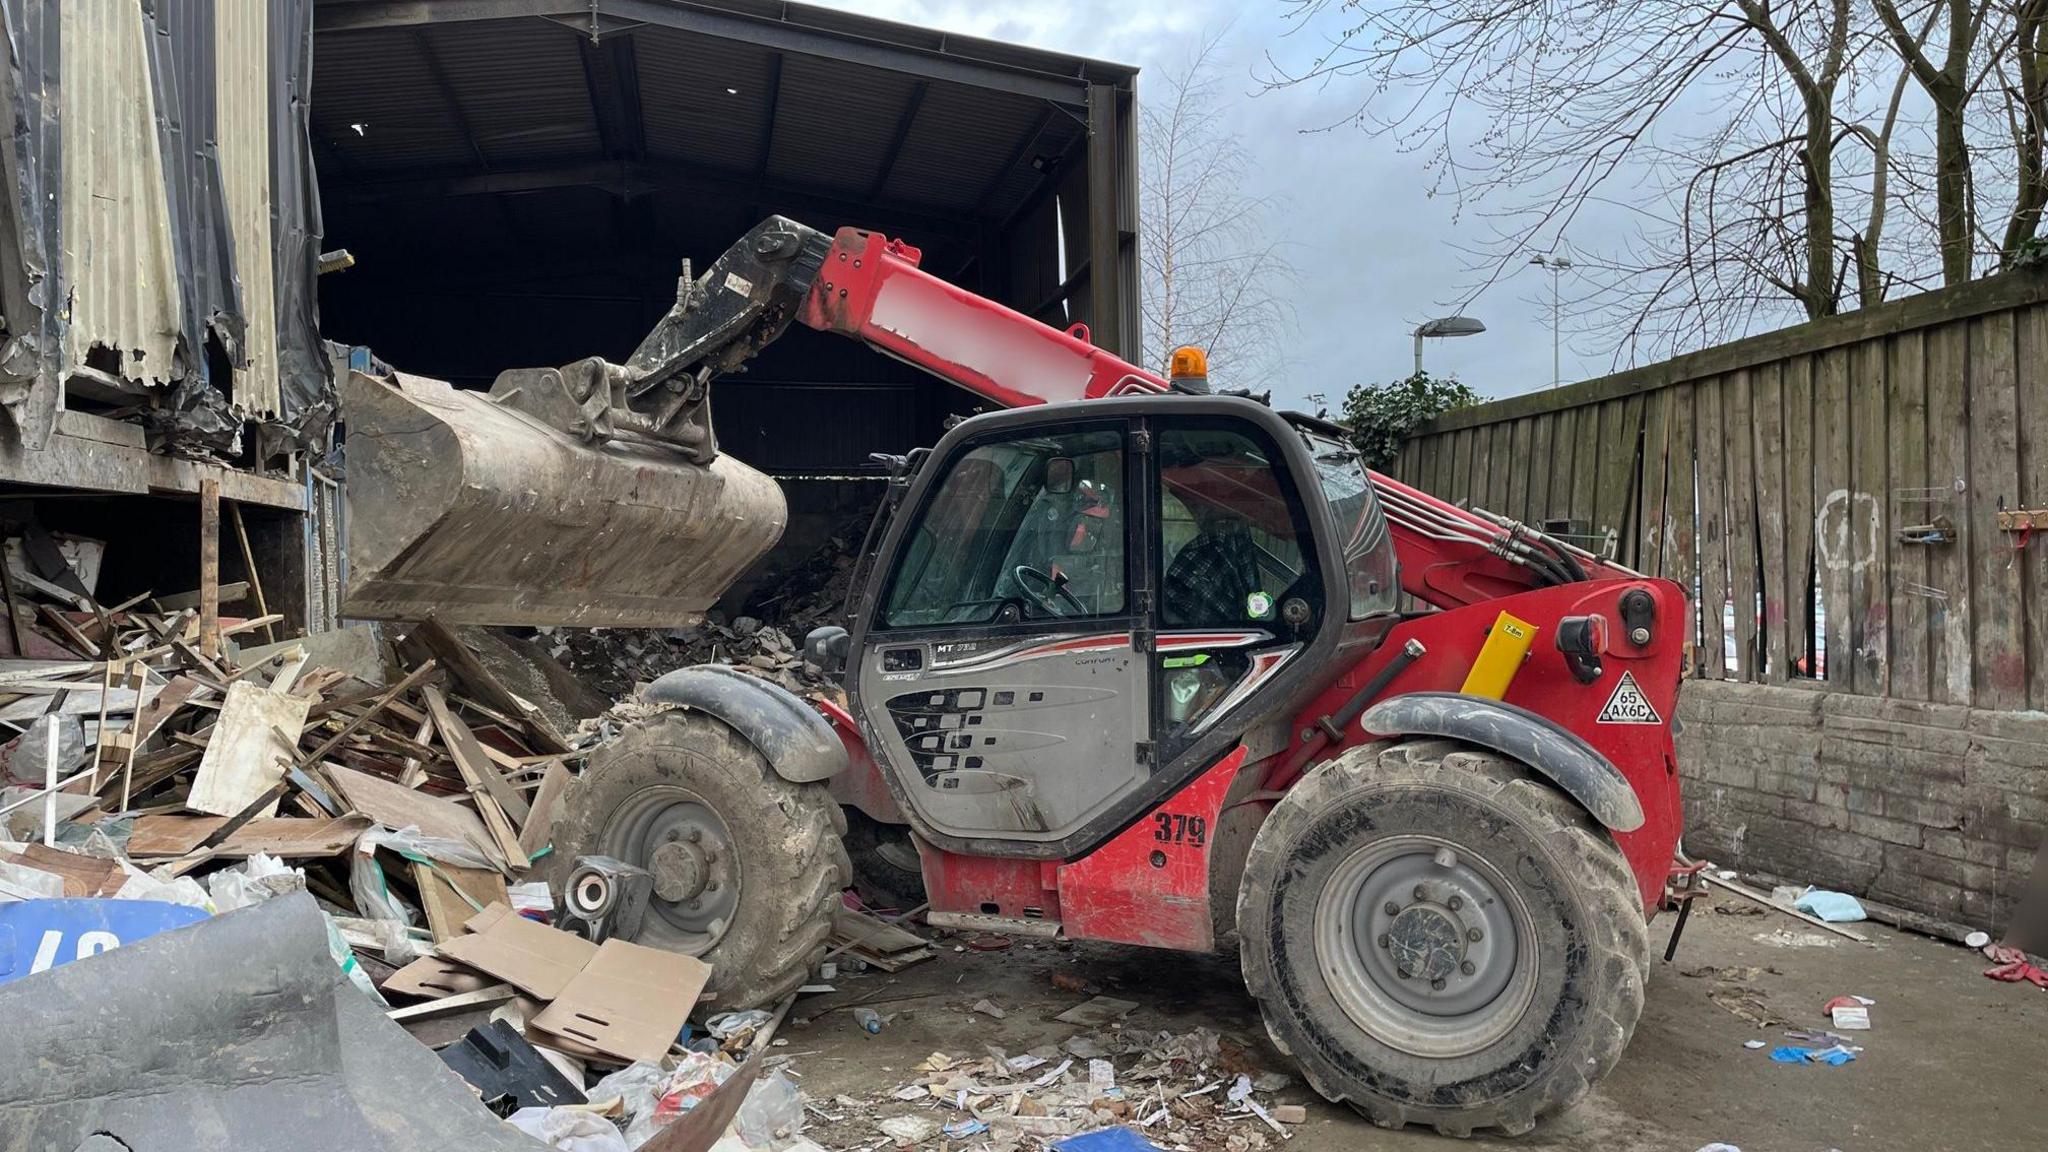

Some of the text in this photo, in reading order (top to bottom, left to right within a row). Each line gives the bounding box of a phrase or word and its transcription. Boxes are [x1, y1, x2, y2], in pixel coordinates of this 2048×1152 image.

[937, 644, 955, 653] MT
[1620, 692, 1637, 704] 65
[1612, 705, 1646, 717] AX6C
[1155, 812, 1206, 848] 379
